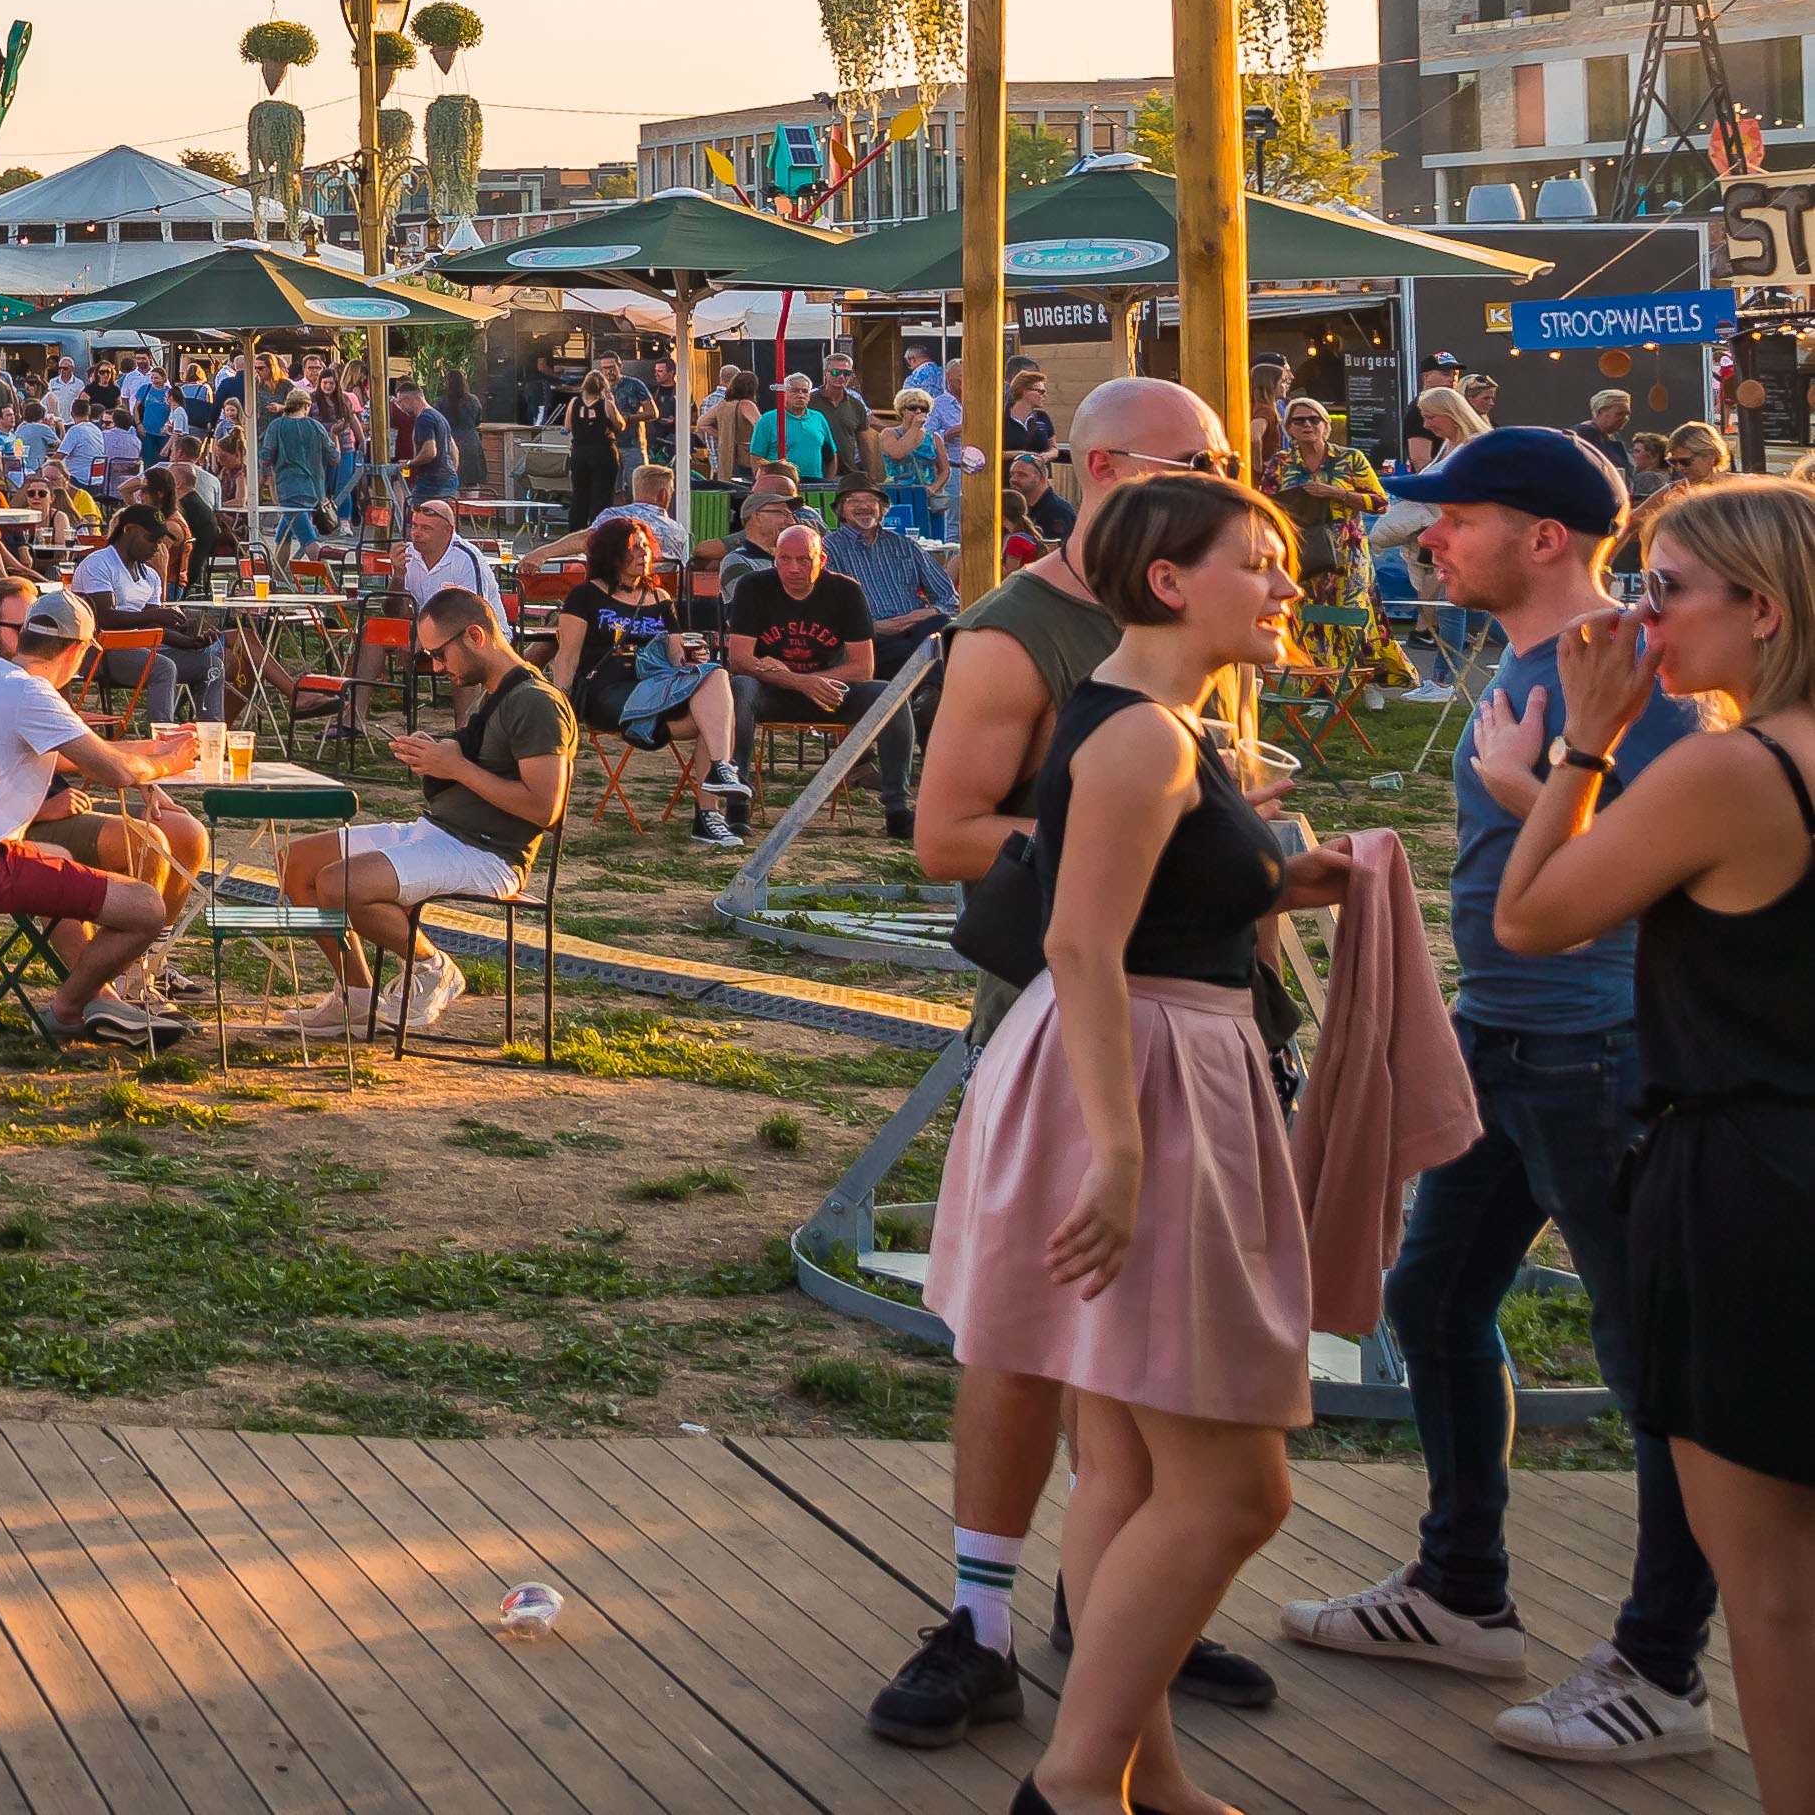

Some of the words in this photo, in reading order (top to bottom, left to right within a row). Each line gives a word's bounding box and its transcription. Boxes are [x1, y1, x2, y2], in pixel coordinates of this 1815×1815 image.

[1024, 304, 1093, 327] BURGERS
[1097, 303, 1109, 323] &
[1540, 304, 1702, 338] STROOPWAFELS
[1345, 354, 1396, 370] Burgers
[788, 620, 839, 647] SLEEP
